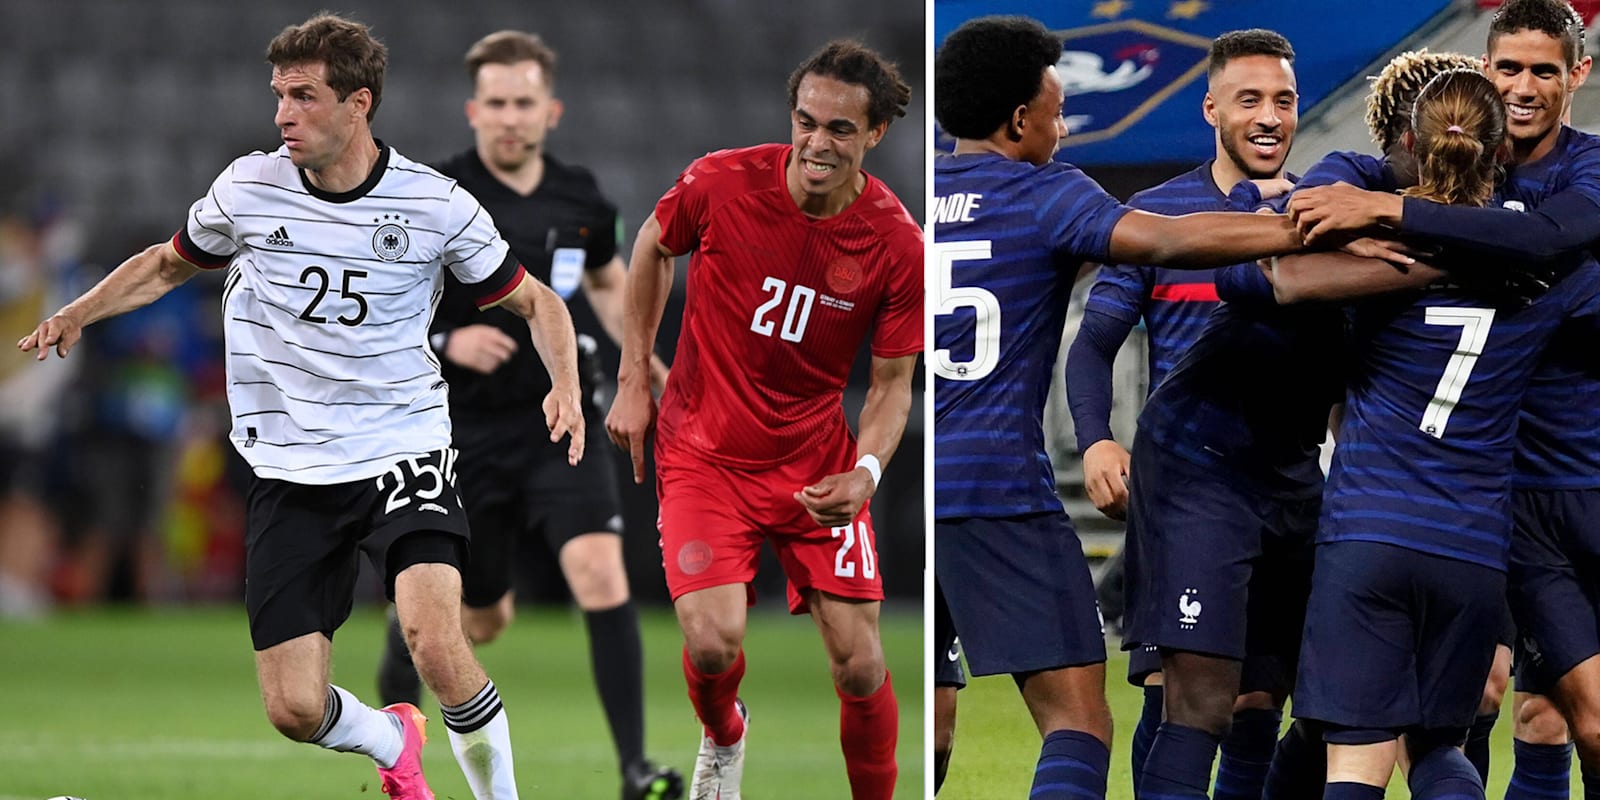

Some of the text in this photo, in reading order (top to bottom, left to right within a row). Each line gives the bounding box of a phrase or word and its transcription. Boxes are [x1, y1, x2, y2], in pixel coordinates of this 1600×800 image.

[265, 238, 294, 247] adidas
[299, 266, 368, 327] 25
[750, 276, 816, 343] 20
[935, 240, 1001, 381] 5
[1419, 306, 1496, 440] 7
[376, 452, 444, 515] 25
[831, 520, 875, 580] 20
